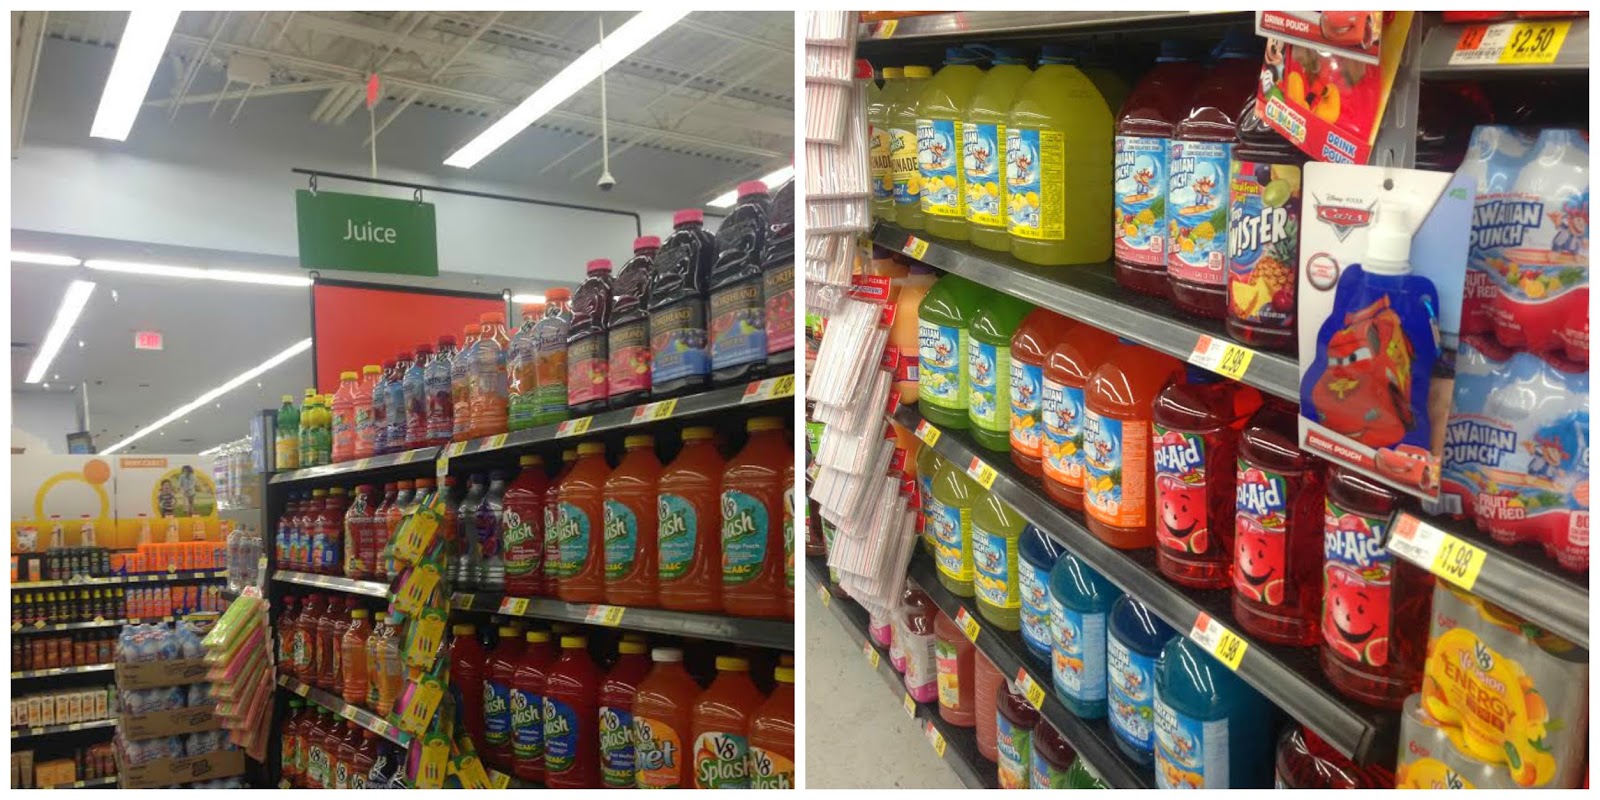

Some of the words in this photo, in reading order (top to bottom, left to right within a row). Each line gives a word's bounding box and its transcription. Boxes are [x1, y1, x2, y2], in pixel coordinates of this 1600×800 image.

[1264, 14, 1285, 27] DRINK
[1286, 18, 1309, 32] POUCH
[1511, 27, 1556, 53] $2.50
[1327, 131, 1357, 157] DRINK
[343, 219, 397, 244] Juice
[1309, 436, 1333, 452] DRINK
[1334, 444, 1362, 461] POUCH
[1479, 493, 1508, 505] FRUIT
[1498, 507, 1526, 520] RED
[1475, 640, 1493, 669] V8
[1445, 660, 1517, 723] ENERGY
[603, 711, 618, 730] V8
[714, 736, 736, 759] V8
[755, 752, 771, 775] V8
